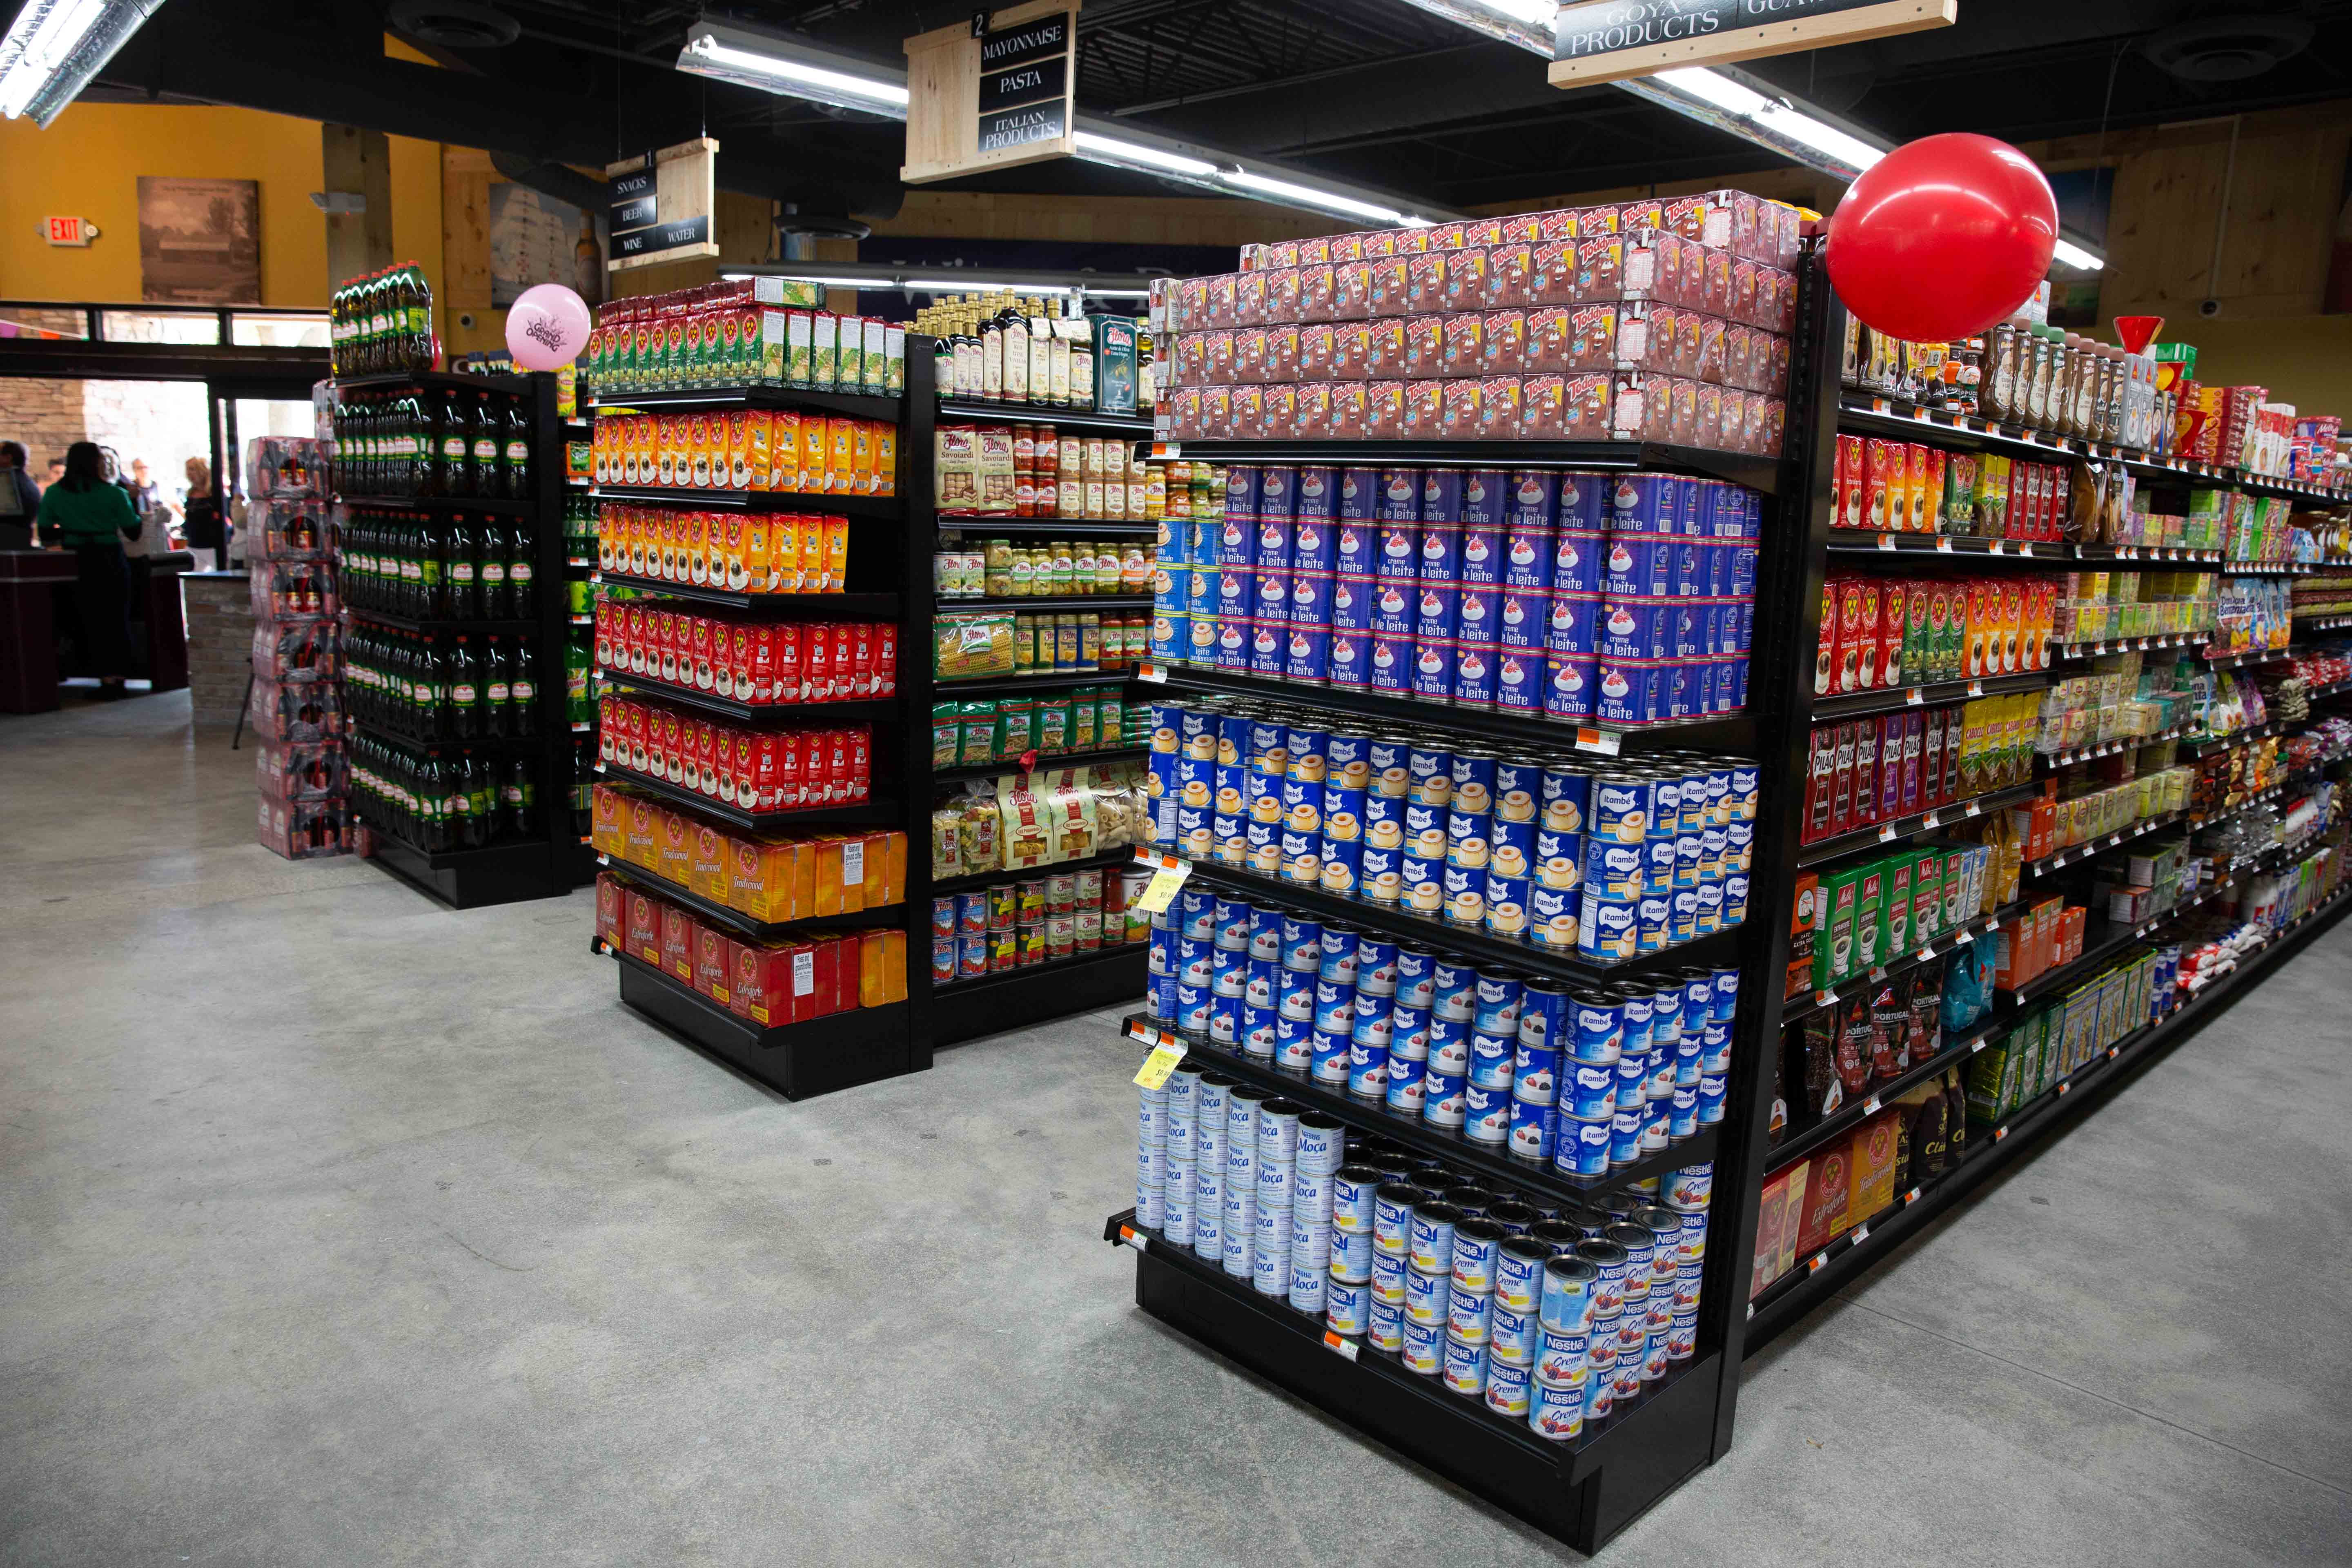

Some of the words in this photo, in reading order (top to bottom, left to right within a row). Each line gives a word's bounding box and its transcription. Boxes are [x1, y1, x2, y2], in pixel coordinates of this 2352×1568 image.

[1606, 0, 1680, 25] GOYA
[976, 14, 983, 36] 2
[1571, 10, 1719, 56] PRODUCTS
[984, 25, 1061, 60] MAYONNAISE
[1000, 70, 1041, 93] PASTA
[996, 111, 1045, 131] ITALIAN
[985, 122, 1055, 149] PRODUCTS
[647, 151, 652, 167] 1
[617, 176, 646, 194] SNACKS
[622, 207, 642, 222] BEER
[1540, 212, 1578, 230] Toddynho
[51, 218, 78, 240] EXIT
[1430, 225, 1463, 243] Toddynho
[624, 237, 642, 251] WINE
[668, 228, 695, 243] WATER
[1579, 235, 1623, 258] Toddynho
[1372, 255, 1406, 276] Toddynho
[1410, 253, 1445, 273] Toddynho
[1447, 249, 1485, 270] Toddynho
[1485, 312, 1524, 333] Toddynho
[1572, 306, 1615, 328] Toddynho
[534, 323, 560, 343] GRAND
[1011, 323, 1026, 340] Flora
[1107, 327, 1132, 346] Flora
[1267, 325, 1298, 345] Toddynho
[1301, 325, 1333, 344] Toddynho
[1369, 320, 1403, 340] Toddynho
[526, 328, 560, 352] OPENING
[1206, 331, 1233, 350] Toddynho
[1368, 381, 1403, 401] Toddynho
[1444, 380, 1481, 401] Toddynho
[1566, 375, 1609, 396] Toddynho
[1233, 387, 1261, 406] Toddynho
[944, 434, 970, 450] Flora
[983, 438, 1008, 453] Flora
[1106, 444, 1123, 454] Flora
[1063, 483, 1078, 491] Flora
[1384, 510, 1390, 519] de
[1394, 510, 1416, 520] leite
[1056, 559, 1071, 569] Flora
[1098, 558, 1116, 569] Flora
[1381, 566, 1388, 575] de
[1392, 566, 1414, 576] leite
[1507, 574, 1514, 584] de
[1517, 575, 1539, 586] leite
[1377, 621, 1383, 630] de
[1386, 622, 1408, 632] leite
[965, 628, 988, 641] Flora
[1196, 647, 1209, 655] leite
[1603, 644, 1610, 655] de
[1615, 646, 1639, 657] leite
[1217, 655, 1223, 664] de
[1225, 656, 1246, 666] leite
[1331, 671, 1336, 680] de
[1338, 672, 1358, 682] leite
[1549, 700, 1557, 711] de
[1561, 702, 1586, 713] leite
[1011, 716, 1027, 725] Flora
[971, 726, 989, 735] Flora
[1332, 746, 1351, 756] itambé
[1372, 753, 1391, 761] itambé
[1413, 761, 1434, 770] itambé
[1009, 789, 1038, 806] Flora
[1604, 795, 1630, 804] itambé
[595, 821, 619, 834] Tradicional
[662, 847, 688, 862] Tradicional
[1611, 855, 1636, 863] itambé
[695, 860, 721, 874] Tradicional
[1404, 866, 1424, 875] itambé
[733, 875, 764, 892] Tradicional
[1604, 913, 1630, 921] itambé
[1861, 911, 1876, 923] EXTRAFORTE
[1834, 920, 1851, 933] EXTRAFORTE
[666, 940, 686, 955] Extraforte
[700, 962, 722, 978] Extraforte
[737, 982, 763, 997] Extraforte
[1481, 988, 1501, 997] itambé
[1913, 995, 1940, 1006] PORTUGAL
[1628, 1007, 1650, 1017] itambé
[1873, 1011, 1909, 1021] PORTUGAL
[1584, 1015, 1609, 1027] itambé
[1478, 1042, 1500, 1052] itambé
[1703, 1082, 1723, 1091] itambé
[1586, 1129, 1608, 1139] itambé
[1300, 1141, 1326, 1153] Moça
[1258, 1172, 1283, 1183] Moça
[1859, 1156, 1895, 1194] Tradicional
[1686, 1178, 1712, 1192] Creme
[1812, 1188, 1848, 1226] Extraforte
[1454, 1258, 1478, 1268] Creme
[1292, 1278, 1318, 1289] Moça
[1451, 1309, 1474, 1321] Creme
[1447, 1361, 1470, 1372] Creme
[1553, 1354, 1584, 1367] Creme
[1493, 1383, 1521, 1394] Creme
[1552, 1407, 1580, 1421] Creme
